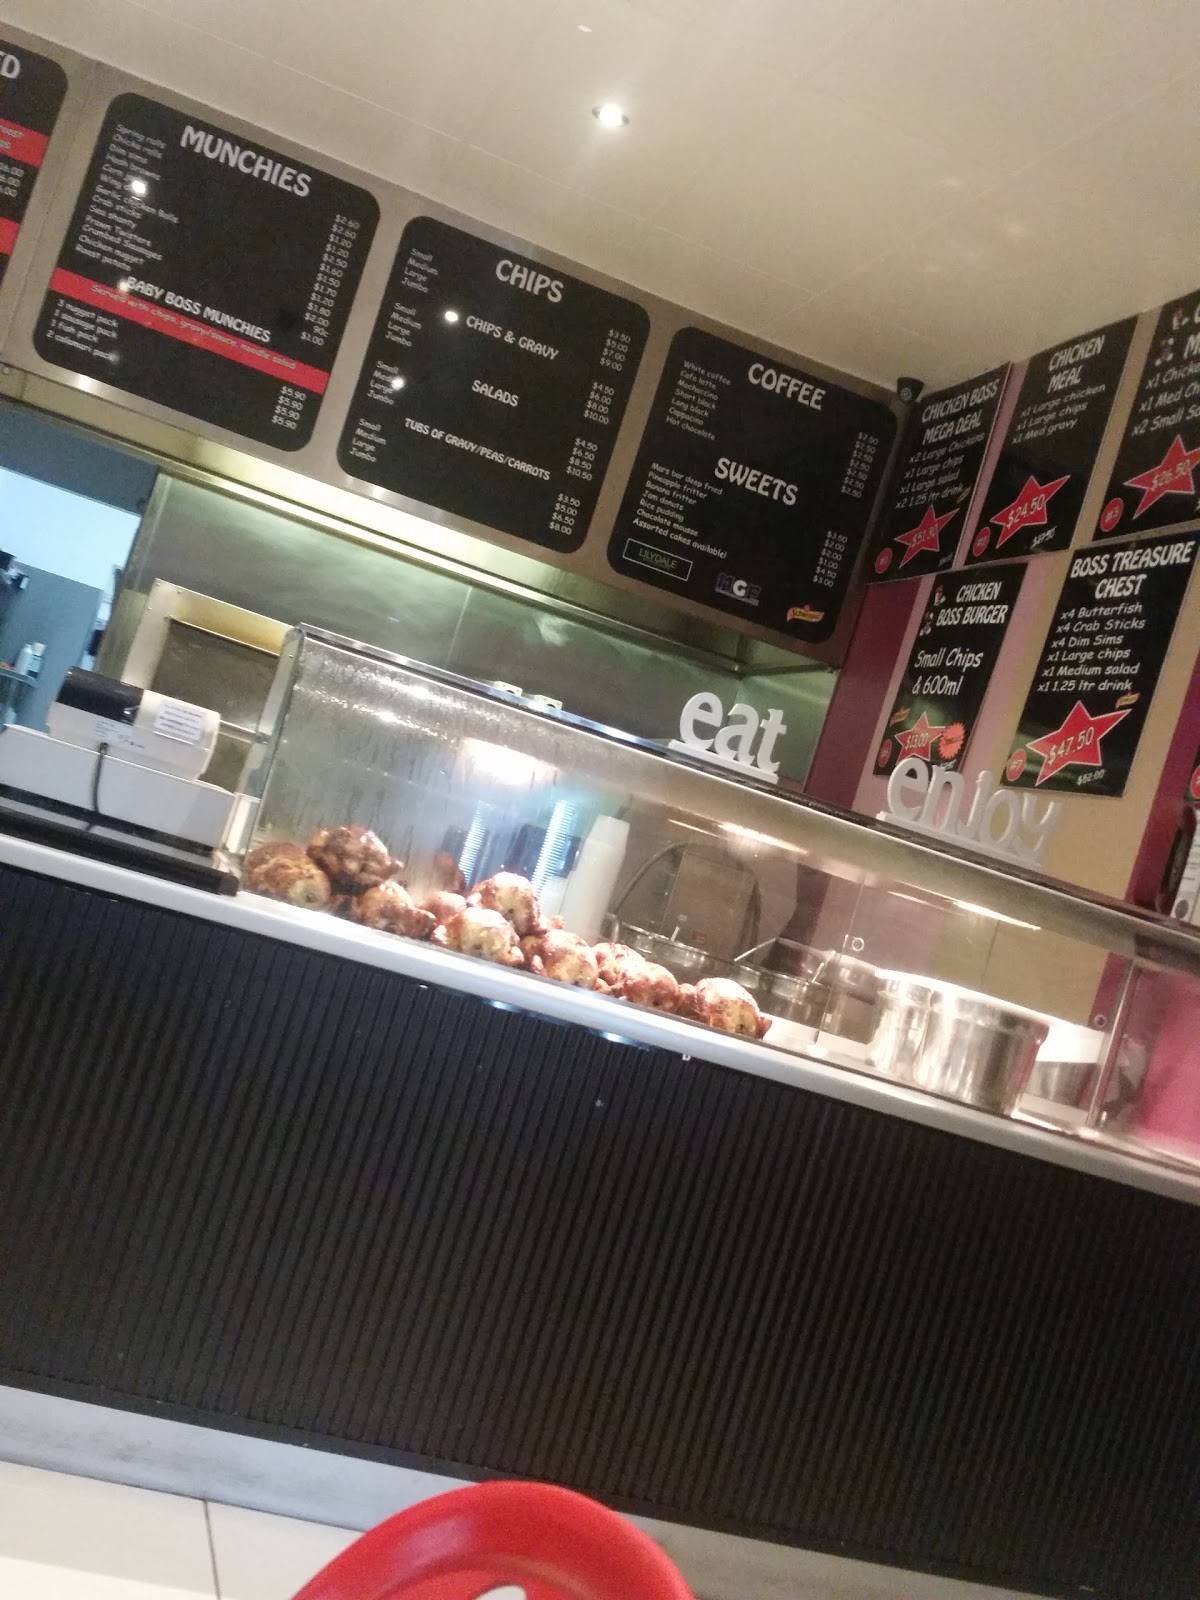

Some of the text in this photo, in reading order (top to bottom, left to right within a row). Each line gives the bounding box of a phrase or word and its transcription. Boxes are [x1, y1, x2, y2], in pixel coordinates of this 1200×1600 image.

[181, 126, 310, 196] MUNCHIES
[404, 267, 427, 282] Large
[407, 257, 438, 275] Medium
[496, 260, 563, 302] CHIPS
[124, 276, 270, 342] BABY BOSS MUNCHIES
[394, 302, 416, 316] Small
[387, 321, 410, 336] Large
[391, 312, 421, 329] Medium
[385, 331, 412, 347] Jumbo
[466, 315, 559, 359] CHIPS & GRAVY
[1049, 336, 1105, 371] CHICKEN
[748, 363, 825, 409] COFFEE
[1048, 366, 1082, 393] MEAL
[278, 395, 303, 410] $5.90
[280, 386, 306, 401] $5.90
[367, 389, 394, 405] Jumbo
[472, 380, 518, 406] SALADS
[589, 391, 612, 405] $6.00
[922, 379, 1000, 423] CHICKEN BOSS
[1033, 398, 1061, 413] Large
[1063, 384, 1106, 402] chicken
[1139, 387, 1183, 412] x1 Med
[272, 415, 297, 430] $5.90
[275, 405, 300, 420] $5.90
[666, 415, 680, 426] Hot
[1028, 412, 1056, 427] Large
[1059, 402, 1088, 417] chips
[1131, 407, 1184, 437] x2 Small
[358, 418, 381, 431] Small
[923, 410, 982, 445] MEGA DEAL
[1025, 425, 1047, 440] Med
[1047, 419, 1078, 436] gravy
[352, 437, 375, 452] Large
[355, 428, 386, 445] Medium
[575, 438, 598, 452] $4.50
[349, 447, 376, 462] Jumbo
[405, 418, 550, 480] TUBS OF GRAVY/PEAS/CARROTS
[572, 447, 595, 461] $6.50
[922, 447, 946, 461] Large
[566, 465, 592, 481] $10.50
[569, 456, 592, 470] $8.50
[916, 463, 940, 477] Large
[942, 455, 964, 469] chips
[648, 471, 707, 499] Pineapple fritter
[651, 462, 723, 495] Mars bar deep fried
[715, 458, 797, 505] SWEETS
[911, 479, 936, 492] Large
[558, 493, 580, 507] $3.50
[642, 490, 684, 511] Jam donuts
[645, 480, 697, 504] Banana fritter
[552, 512, 575, 526] $6.50
[555, 503, 577, 516] $5.00
[640, 498, 684, 523] Rice pudding
[1007, 493, 1045, 528] $24.50
[549, 521, 572, 535] $8.00
[637, 508, 698, 536] Chocolate mousse
[633, 518, 727, 558] Assorted cakes available!
[1070, 541, 1195, 578] BOSS TREASURE
[956, 582, 1002, 602] CHICKEN
[1095, 574, 1147, 599] CHEST
[936, 605, 1008, 626] BOSS BURGER
[1060, 602, 1142, 620] x4 Butterfish
[1056, 617, 1146, 633] x4 Crab Sticks
[1051, 634, 1124, 648] x4 Dim Sims
[914, 648, 983, 672] Small Chips
[1047, 648, 1131, 663] x1 Large chips
[1042, 662, 1140, 677] x1 Medium salad
[912, 675, 964, 695] & 600ml
[1037, 679, 1132, 692] x1 1.25 ltr drink
[679, 692, 788, 774] eat
[1047, 726, 1095, 767] $47.50
[886, 757, 1064, 857] enjoy
